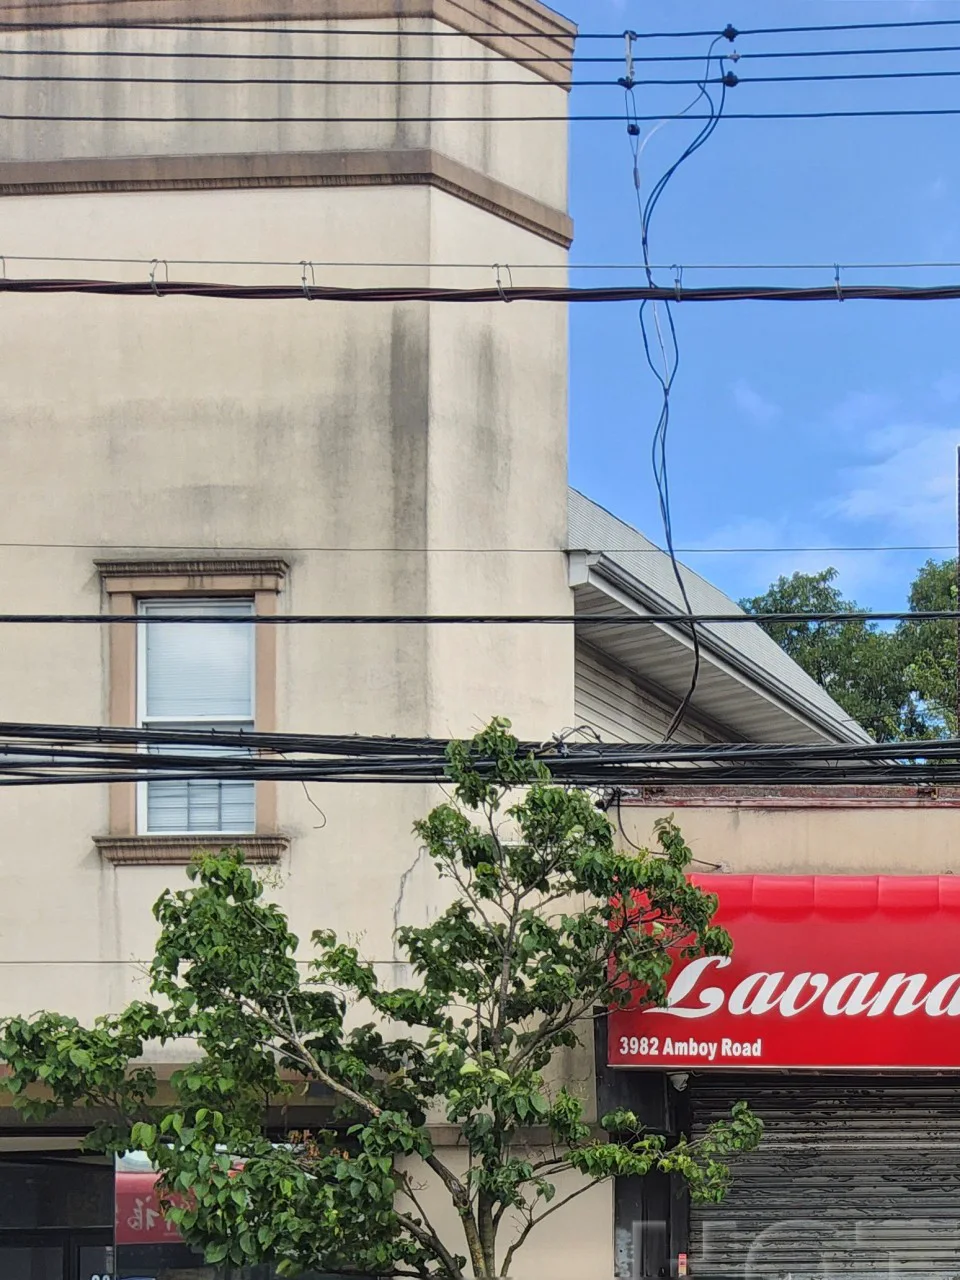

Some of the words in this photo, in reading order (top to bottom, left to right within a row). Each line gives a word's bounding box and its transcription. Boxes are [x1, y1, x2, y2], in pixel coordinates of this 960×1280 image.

[620, 1037, 659, 1056] 3982
[663, 1037, 718, 1061] Amboy
[721, 1038, 762, 1057] Road
